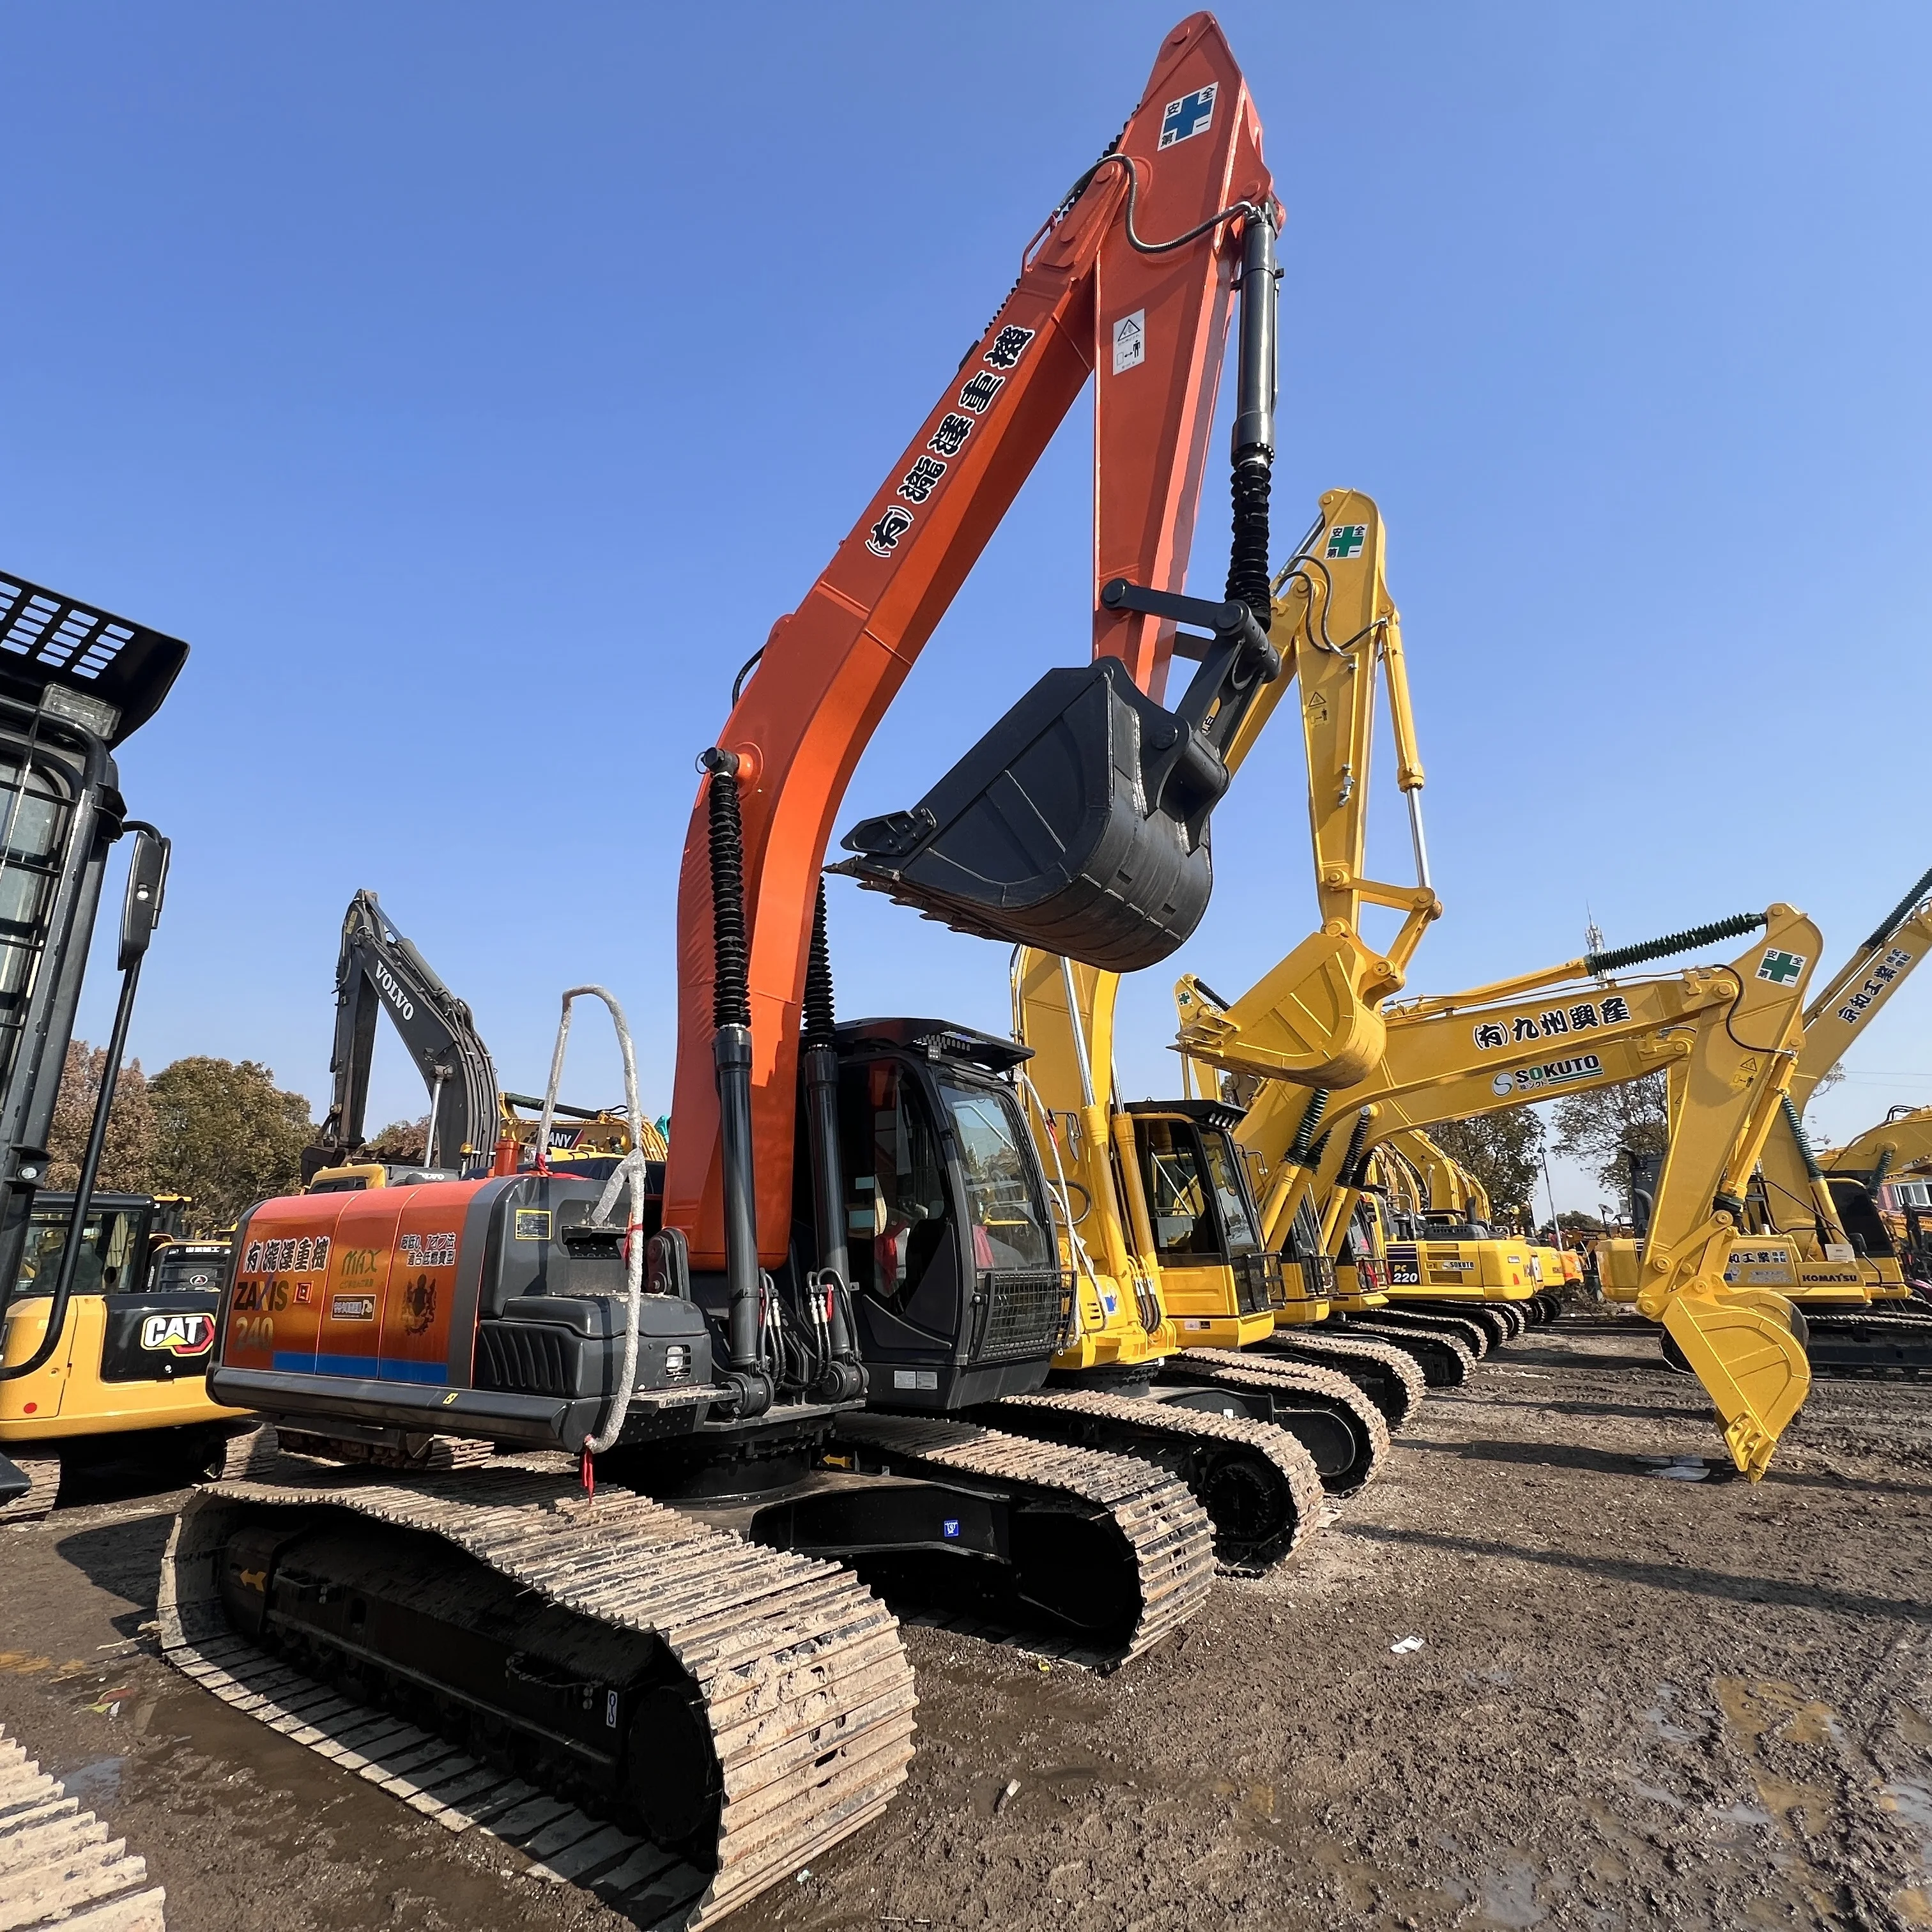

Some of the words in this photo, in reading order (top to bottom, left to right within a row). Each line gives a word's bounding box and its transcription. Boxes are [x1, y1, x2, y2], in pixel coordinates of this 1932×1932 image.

[375, 960, 415, 1021] VOLVO
[1514, 1055, 1599, 1084] SOKUTO
[548, 1131, 572, 1148] ANY
[410, 1172, 445, 1181] LVO
[341, 1250, 382, 1276] MAX
[1393, 1273, 1418, 1283] 220
[1802, 1273, 1857, 1282] KOMATSU
[234, 1279, 289, 1311] ZAXIS
[144, 1316, 203, 1347] CAT
[233, 1317, 273, 1351] 240
